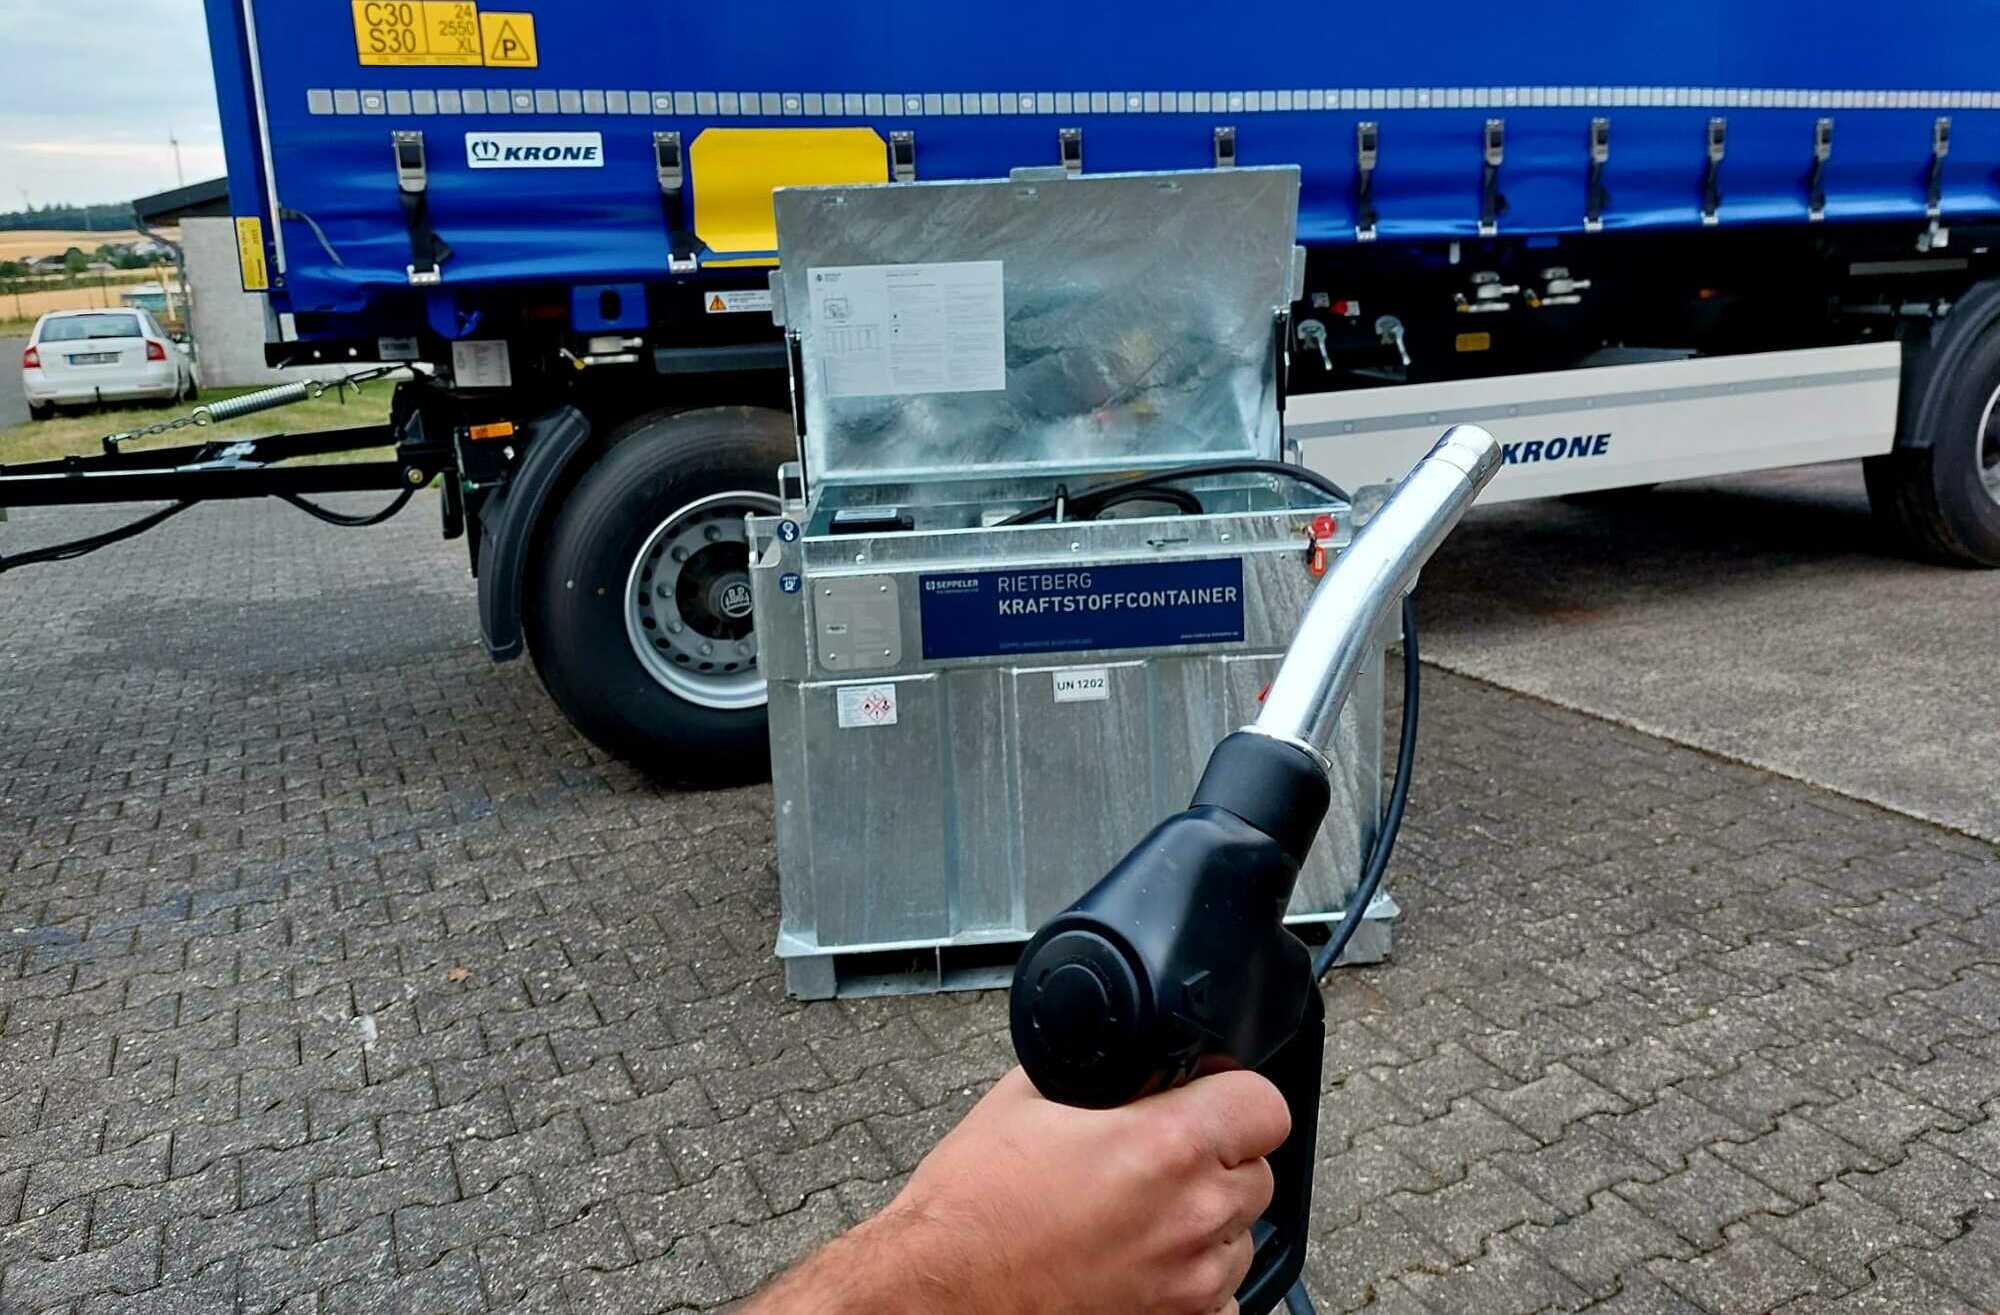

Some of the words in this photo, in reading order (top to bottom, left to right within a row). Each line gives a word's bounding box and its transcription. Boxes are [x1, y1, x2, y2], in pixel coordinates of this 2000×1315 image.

[365, 3, 413, 27] C30
[455, 5, 473, 19] 24
[369, 28, 416, 53] S30
[502, 39, 517, 58] P
[504, 146, 598, 161] KRONE
[1502, 433, 1612, 464] KRONE
[998, 573, 1092, 593] RIETBERG
[999, 586, 1238, 615] KRAFTSTOFFCONTAINER
[1057, 681, 1074, 691] UN
[1078, 679, 1104, 689] 1202
